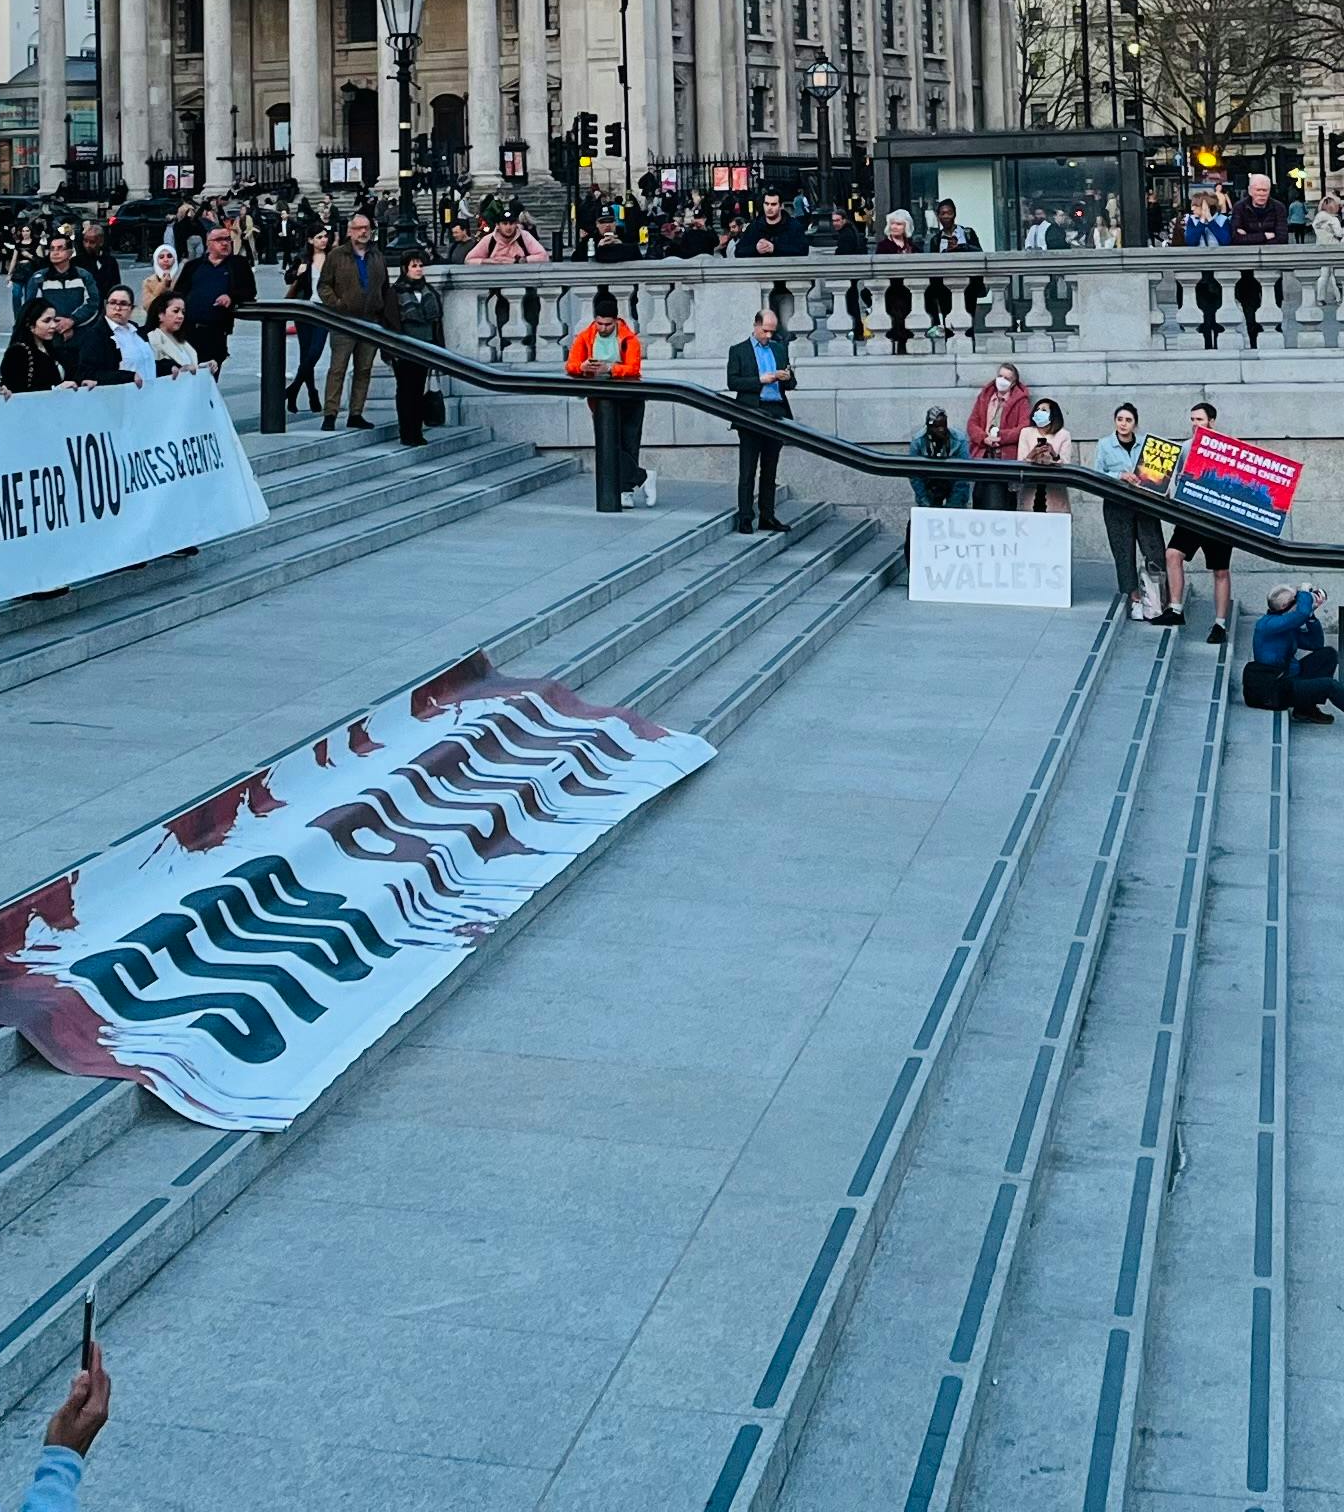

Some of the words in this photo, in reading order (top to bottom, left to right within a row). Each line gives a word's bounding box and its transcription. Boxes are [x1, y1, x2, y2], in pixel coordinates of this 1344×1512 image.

[1146, 437, 1181, 455] STOP
[1200, 435, 1241, 457] DON'T
[1240, 447, 1296, 478] FINANCE
[1143, 452, 1174, 472] WAR
[1197, 446, 1236, 469] PUTIN'S
[1236, 460, 1257, 476] WAR
[1258, 468, 1291, 487] CHEST!
[29, 465, 68, 534] FOR
[66, 431, 121, 523] YOU
[123, 446, 175, 494] LADIES
[167, 440, 186, 478] &
[182, 431, 224, 477] GENTS!
[927, 517, 1029, 541] BLOCK
[934, 542, 1018, 559] PUTIN
[924, 562, 1065, 591] WALLETS
[69, 854, 399, 1064] STOP
[305, 692, 635, 899] PUTIN
